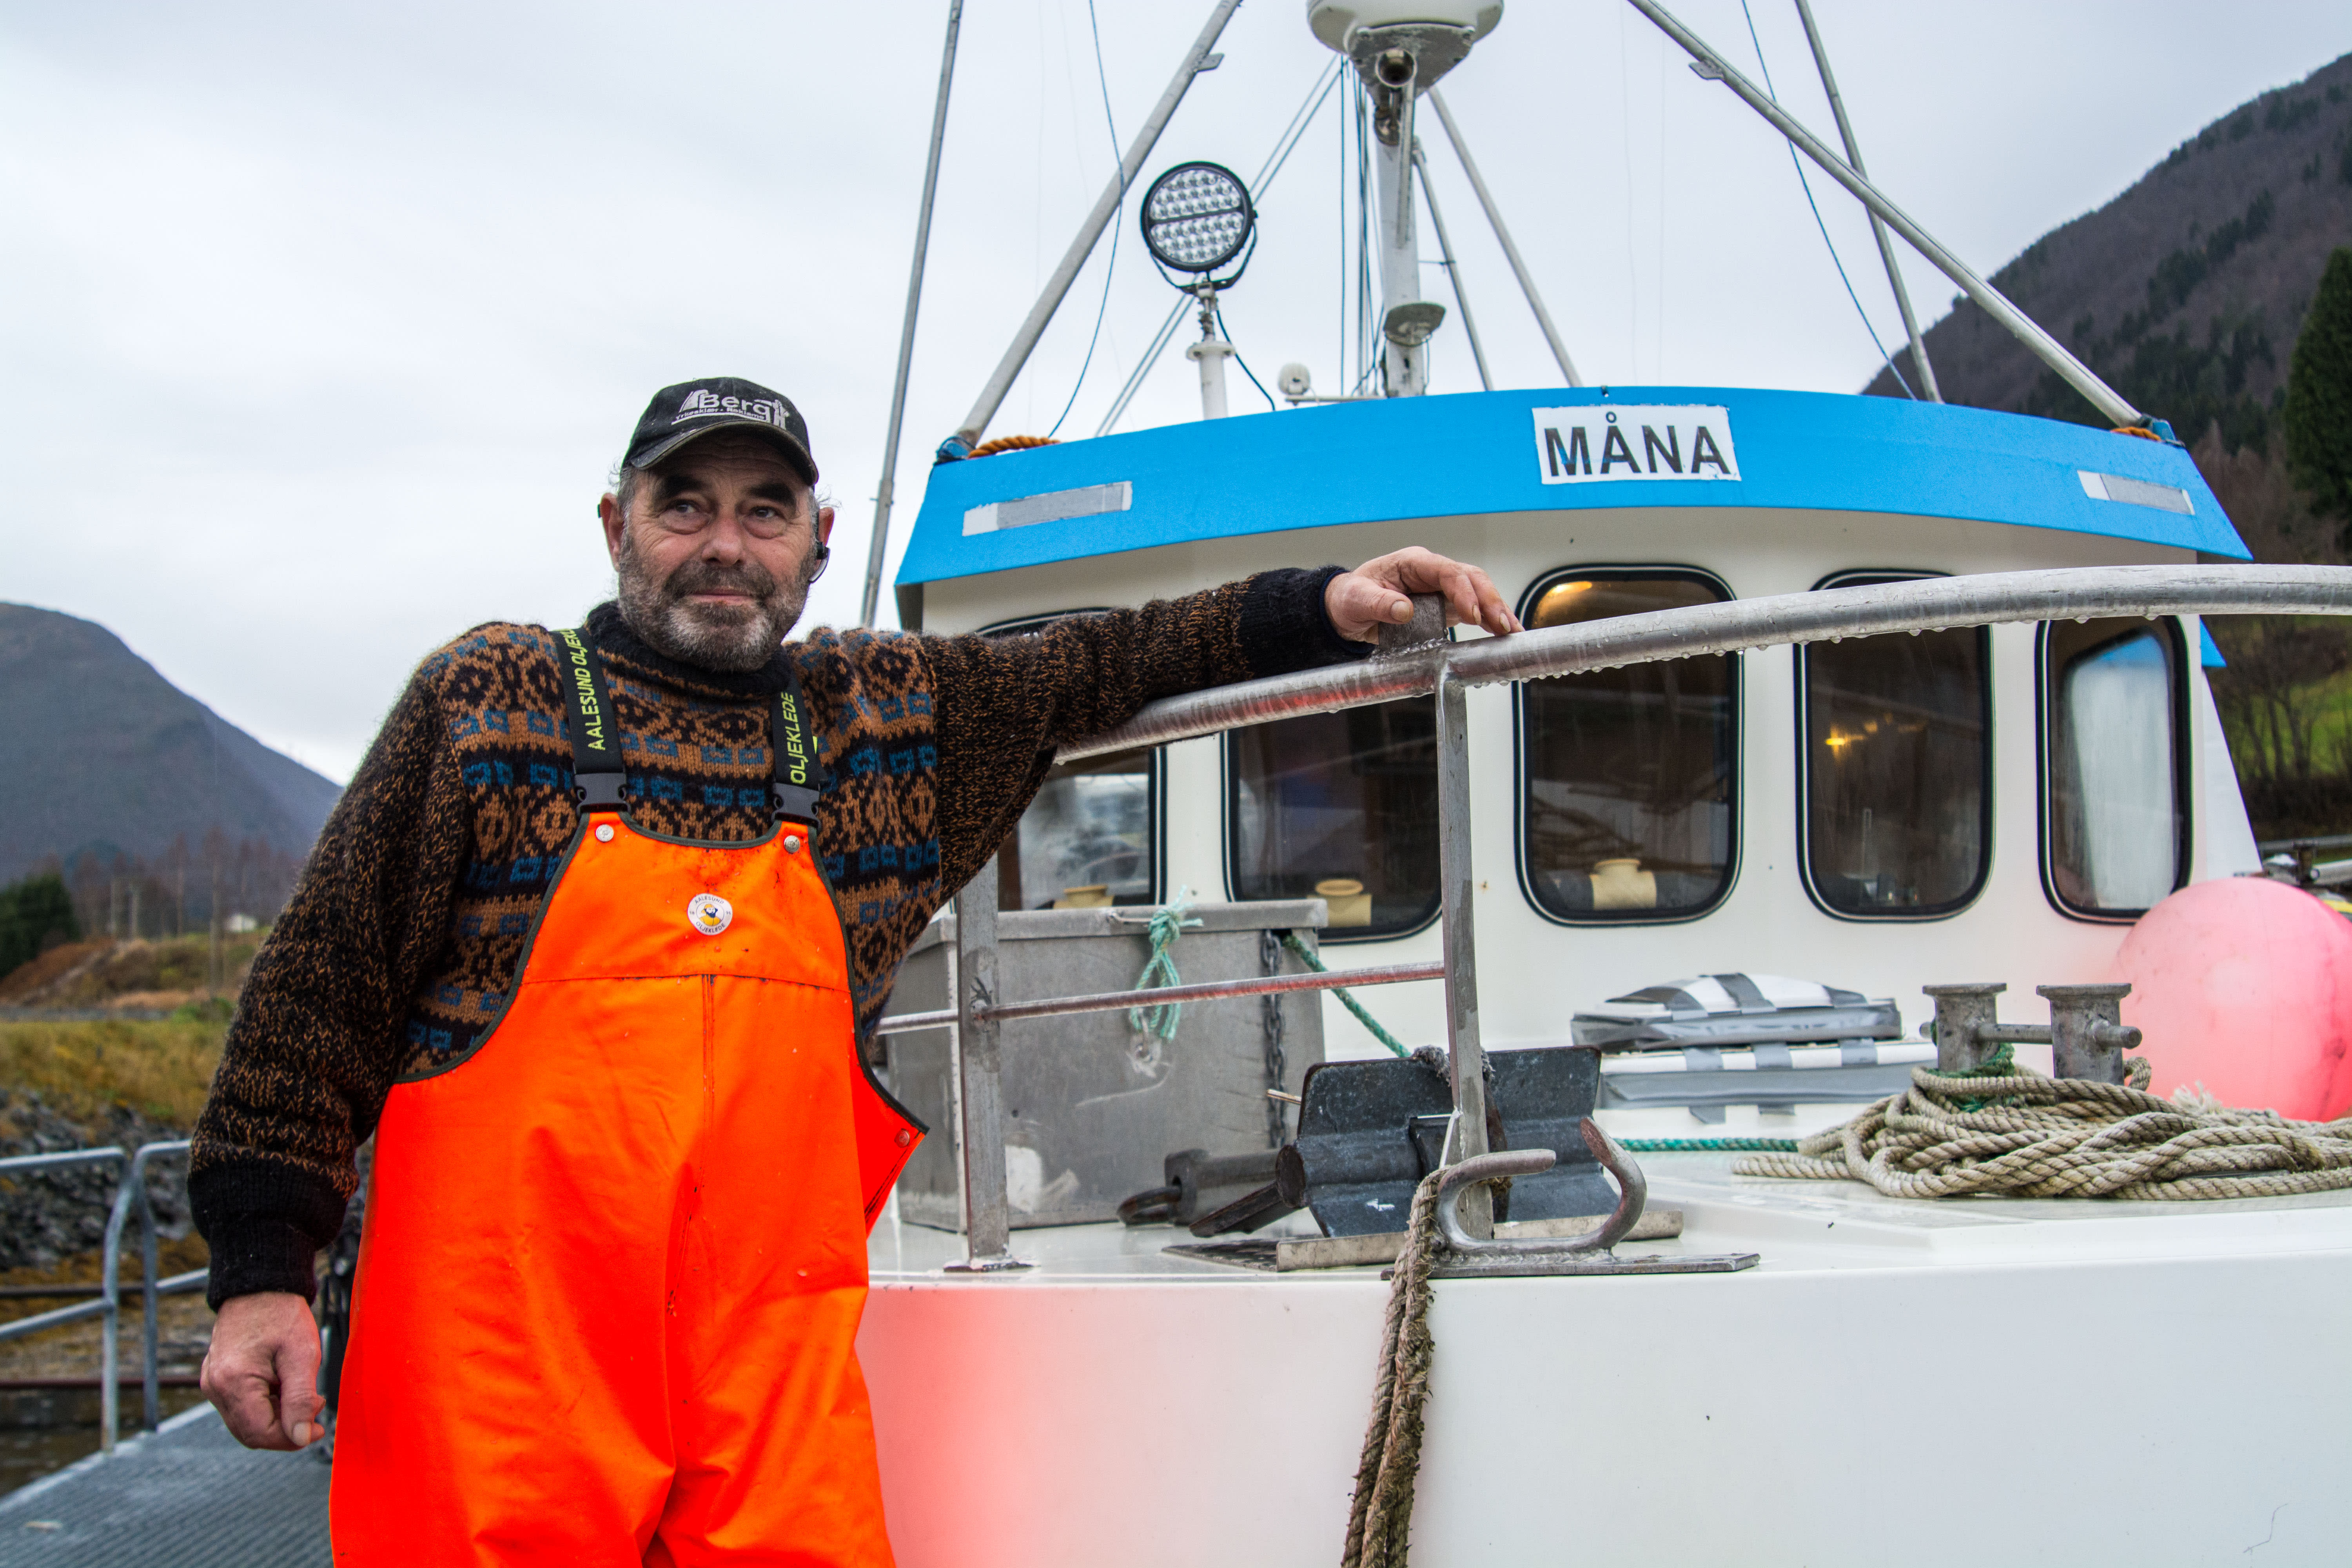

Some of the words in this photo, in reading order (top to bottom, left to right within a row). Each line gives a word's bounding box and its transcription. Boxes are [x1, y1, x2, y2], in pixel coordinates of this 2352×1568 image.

[699, 394, 771, 423] Berg
[1544, 411, 1731, 477] MÅNA
[555, 628, 588, 666] OLJEKL
[574, 667, 606, 751] AALESUND
[780, 691, 809, 784] OLJEKLEDE
[695, 895, 724, 904] AALESUND
